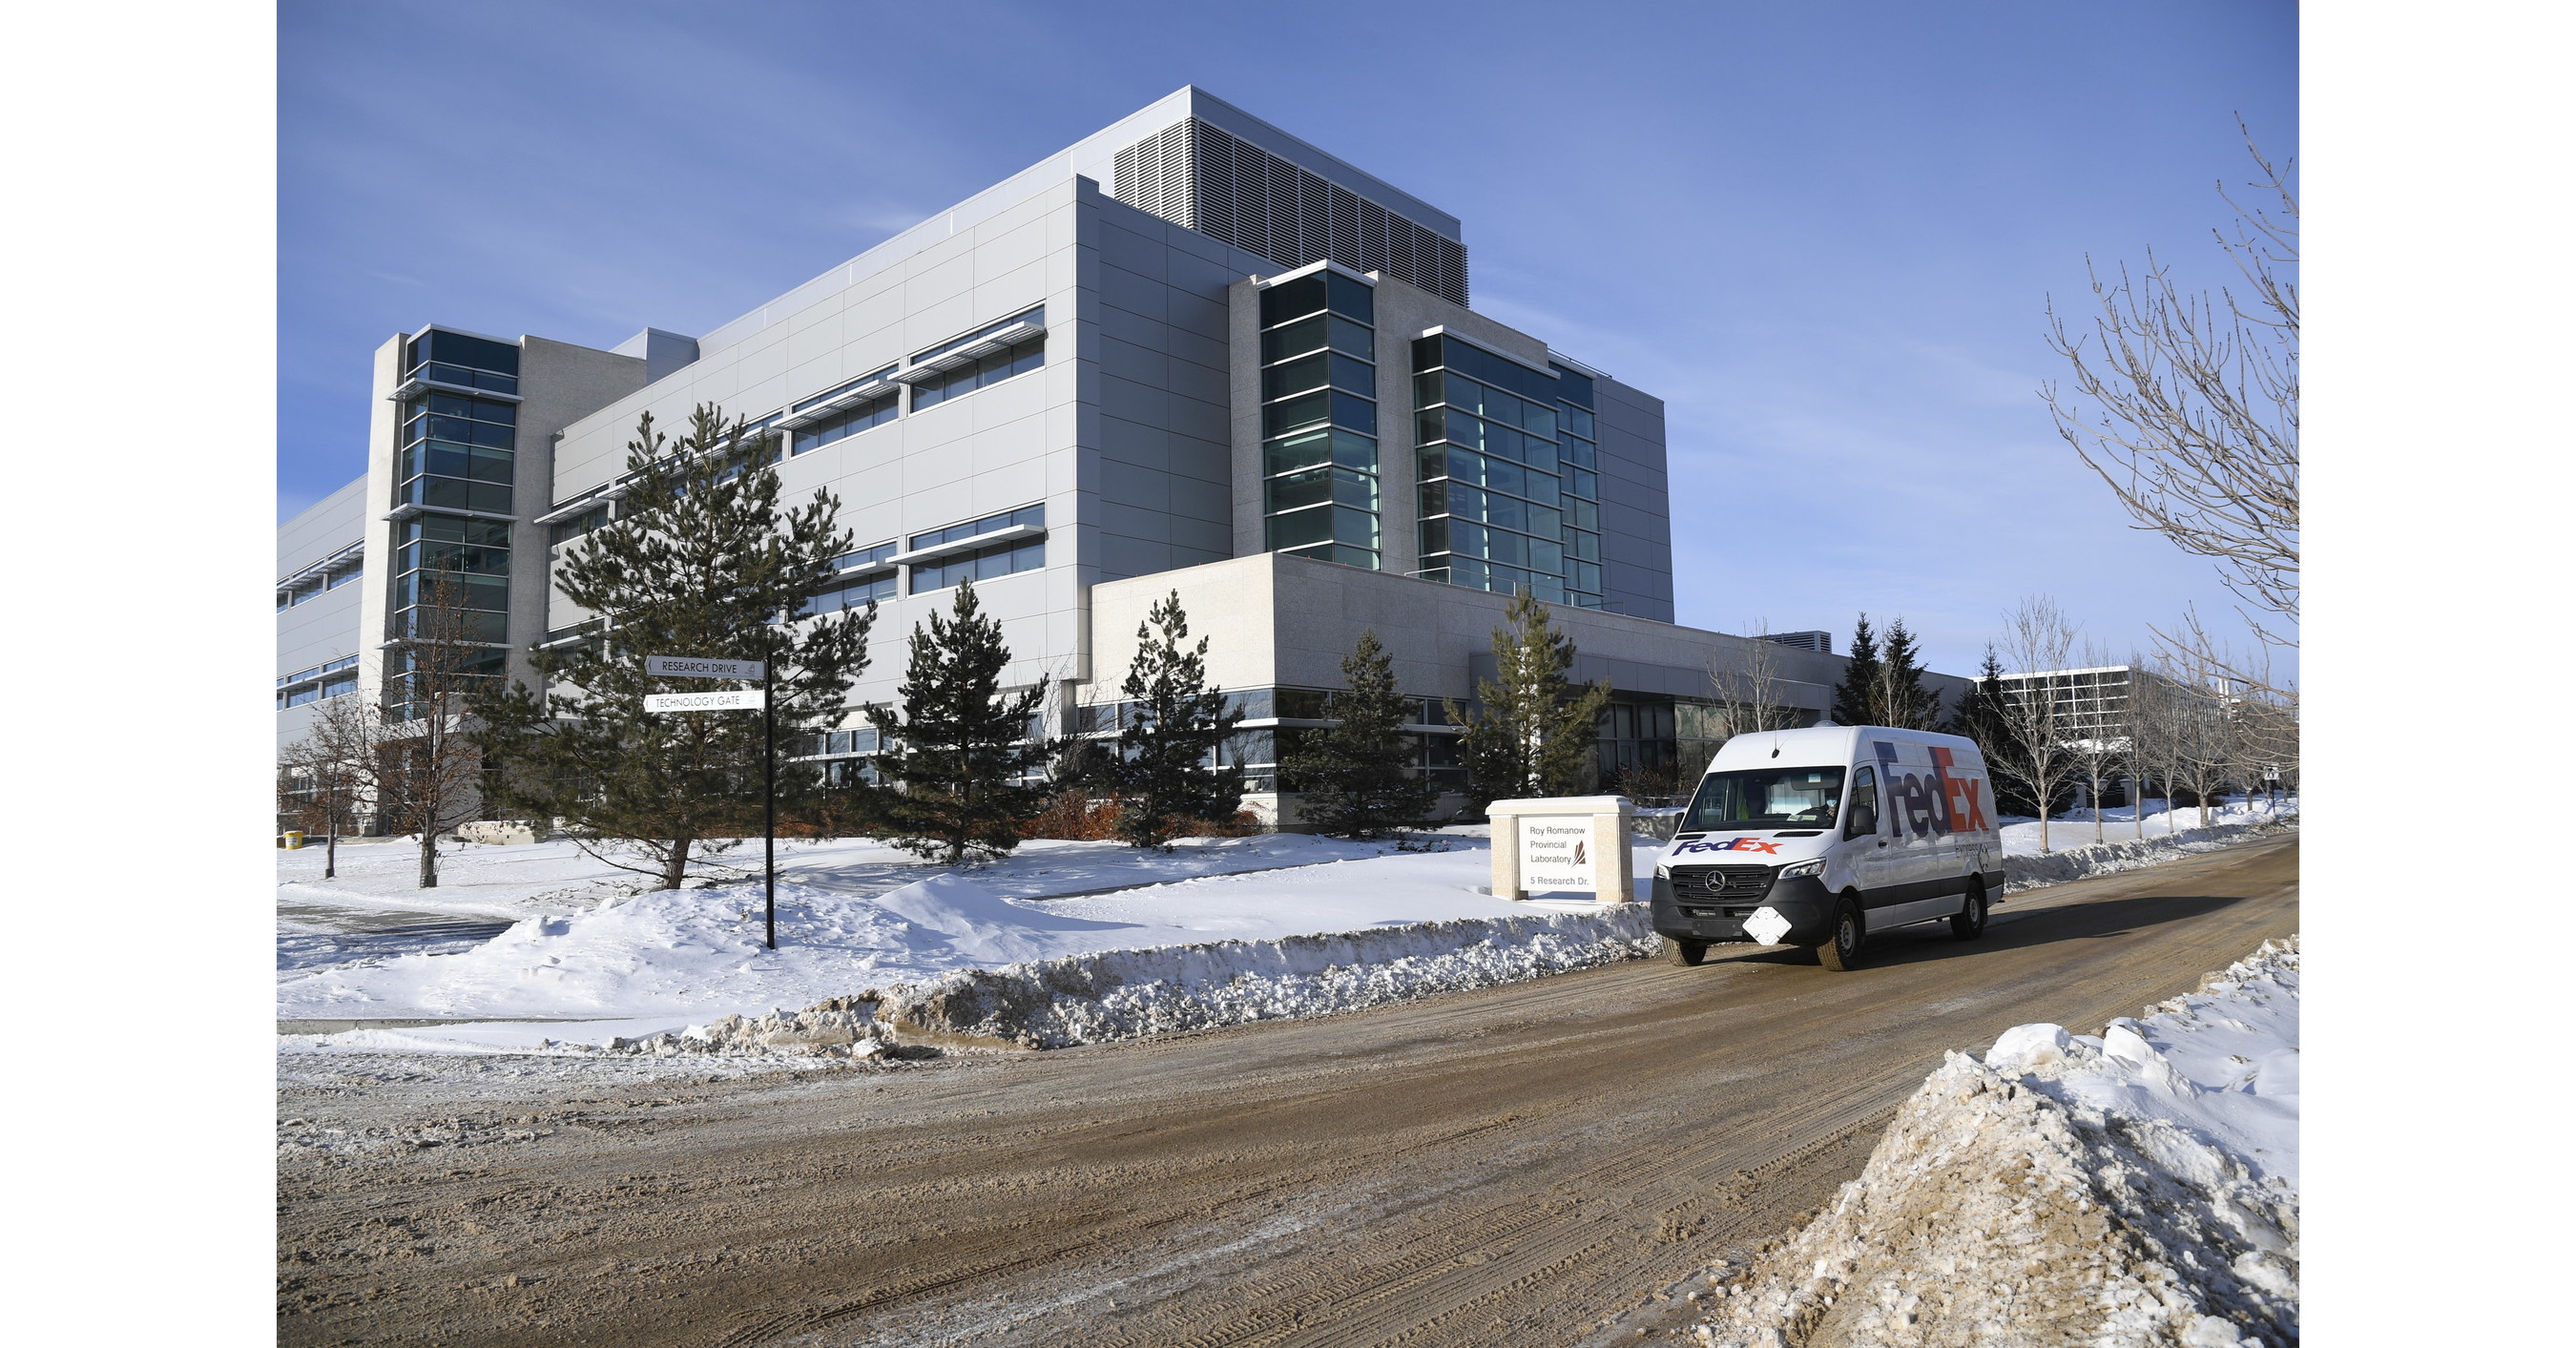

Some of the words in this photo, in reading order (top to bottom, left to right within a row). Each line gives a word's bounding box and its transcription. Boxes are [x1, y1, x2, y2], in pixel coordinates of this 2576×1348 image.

[662, 661, 709, 673] RESEARCH
[712, 663, 737, 674] DRIVE
[656, 697, 715, 708] TECHNOLOGY
[717, 695, 740, 705] GATE
[1873, 741, 1989, 838] FedEx
[1530, 826, 1545, 837] Roy
[1547, 826, 1586, 835] Romanow
[1530, 840, 1567, 849] Provincial
[1672, 837, 1784, 857] FedEx
[1530, 855, 1571, 864] Laboratory
[1537, 877, 1575, 885] Research
[1577, 877, 1589, 885] Dr.
